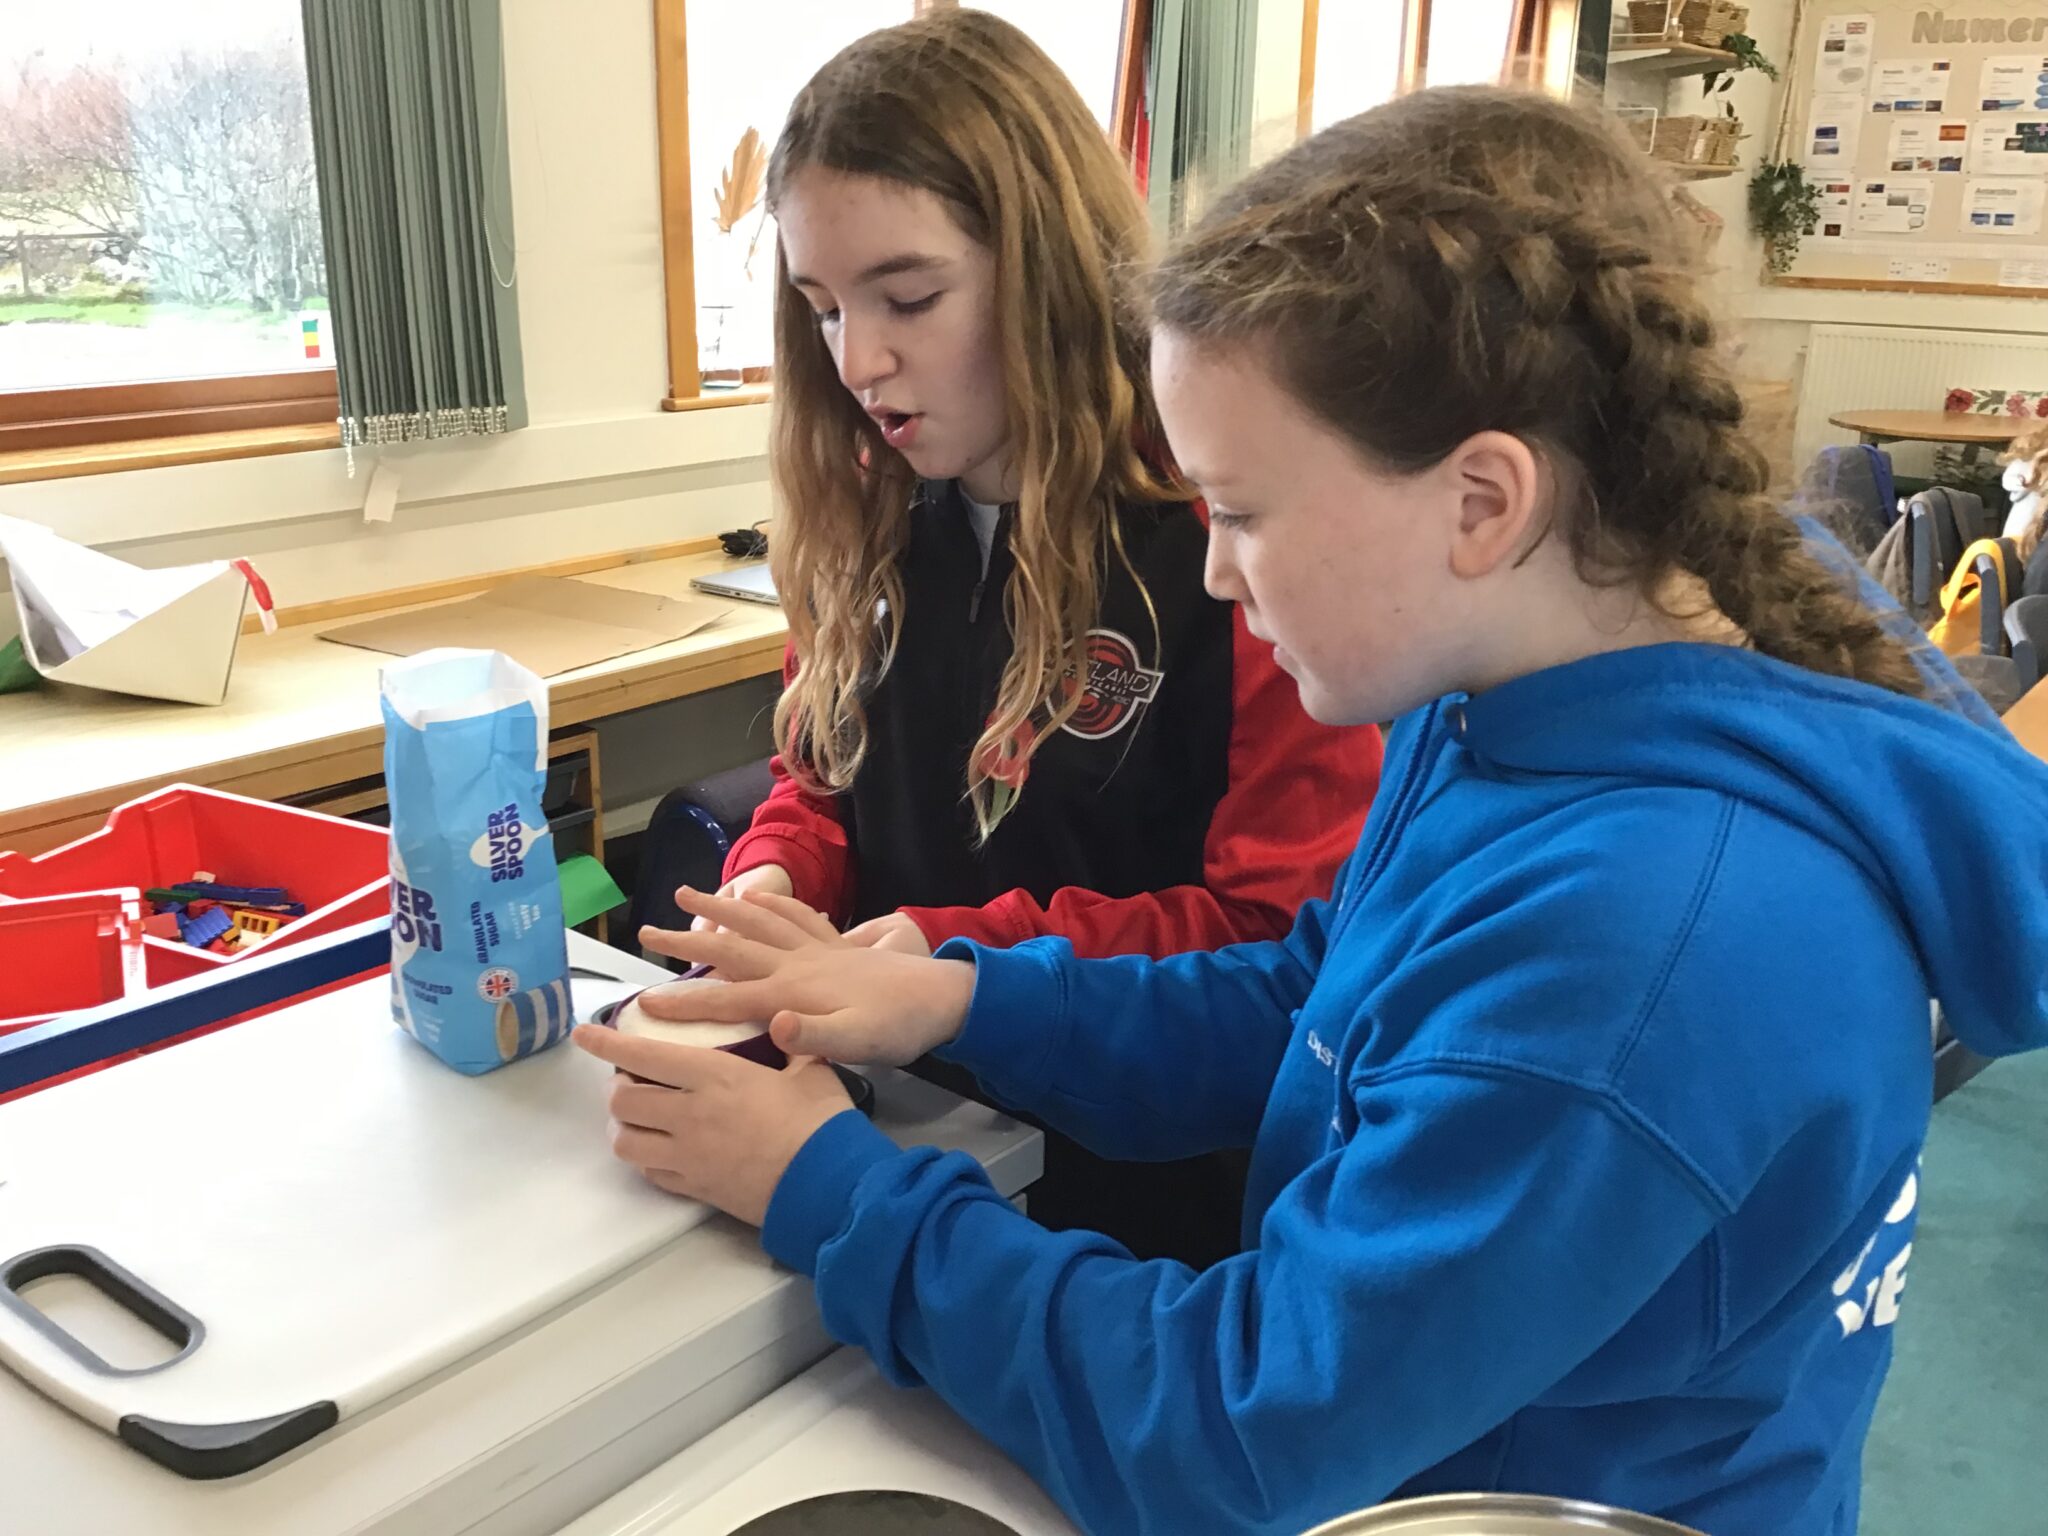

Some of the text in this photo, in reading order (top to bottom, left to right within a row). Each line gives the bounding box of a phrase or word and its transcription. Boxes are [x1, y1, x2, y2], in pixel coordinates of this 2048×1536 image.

[1087, 660, 1150, 692] LAND
[487, 809, 507, 883] SILVER
[504, 802, 524, 880] SPOON
[470, 901, 489, 964] GRANULATED
[484, 912, 500, 946] SUGAR
